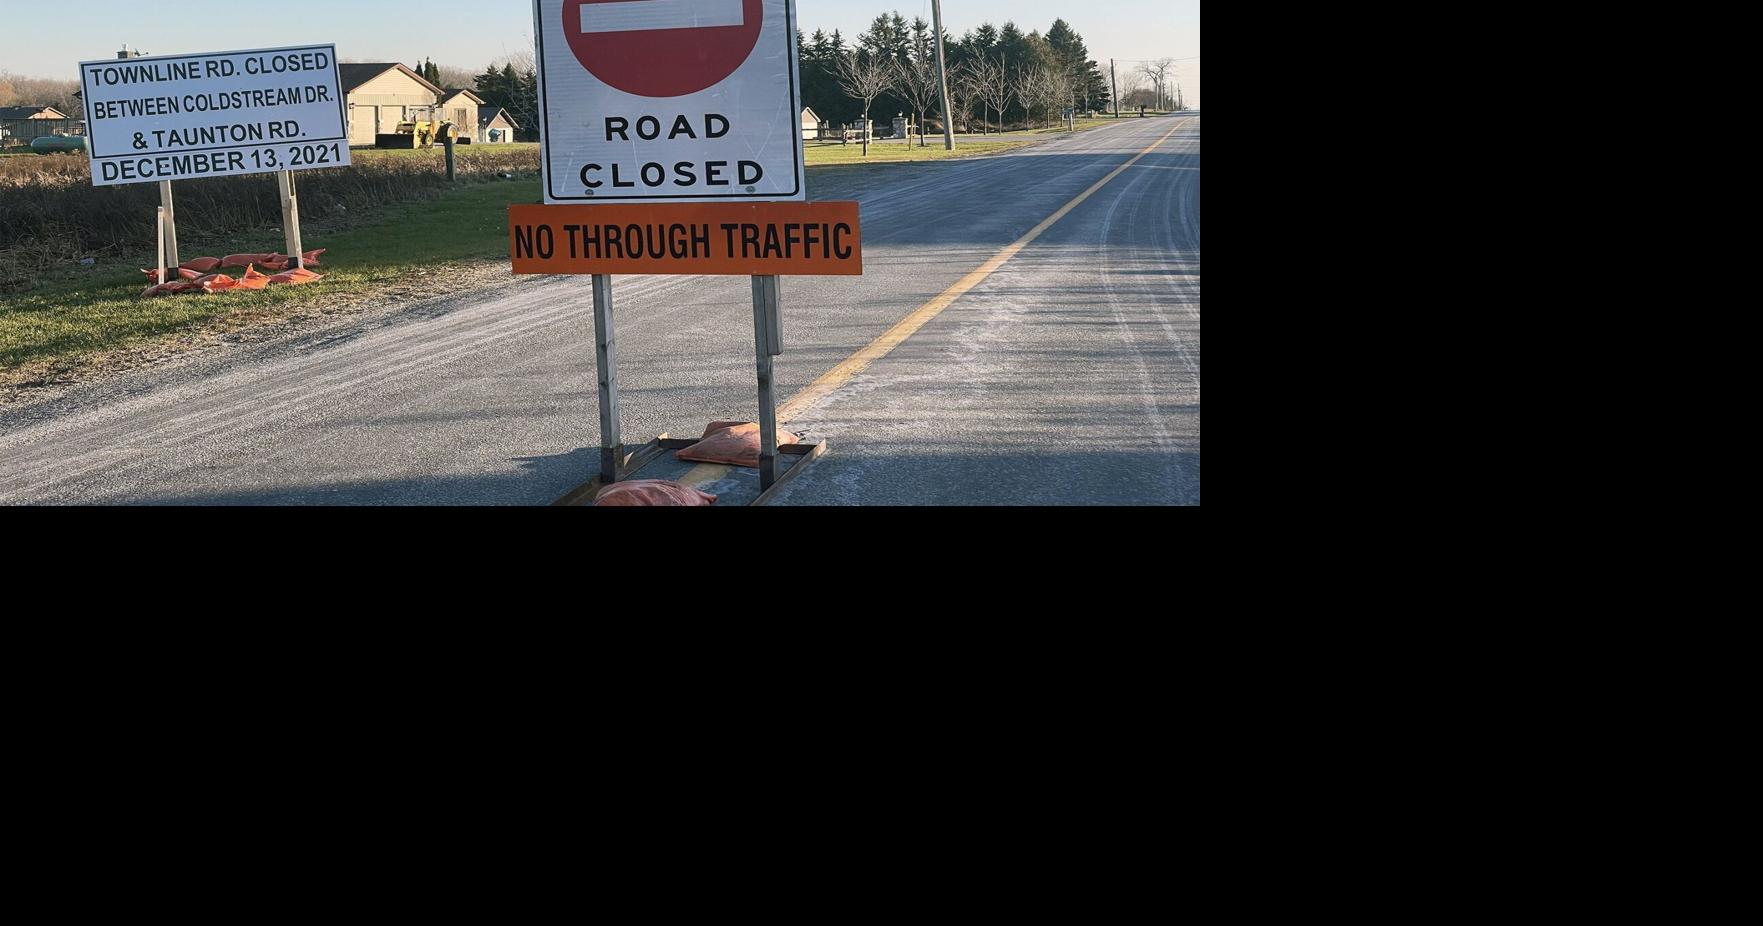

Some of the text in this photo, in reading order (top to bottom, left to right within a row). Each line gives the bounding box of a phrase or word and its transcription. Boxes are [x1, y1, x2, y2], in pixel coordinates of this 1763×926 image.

[90, 52, 328, 86] TOWNLINE RD. CLOSED
[94, 85, 334, 120] BETWEEN COLDSTREAM DR.
[132, 120, 306, 150] & TAUNTON RD.
[605, 113, 730, 141] ROAD
[101, 143, 341, 182] DECEMBER 13, 2021
[580, 160, 763, 189] CLOSED
[514, 222, 853, 260] NO THROUGH TRAFFIC
